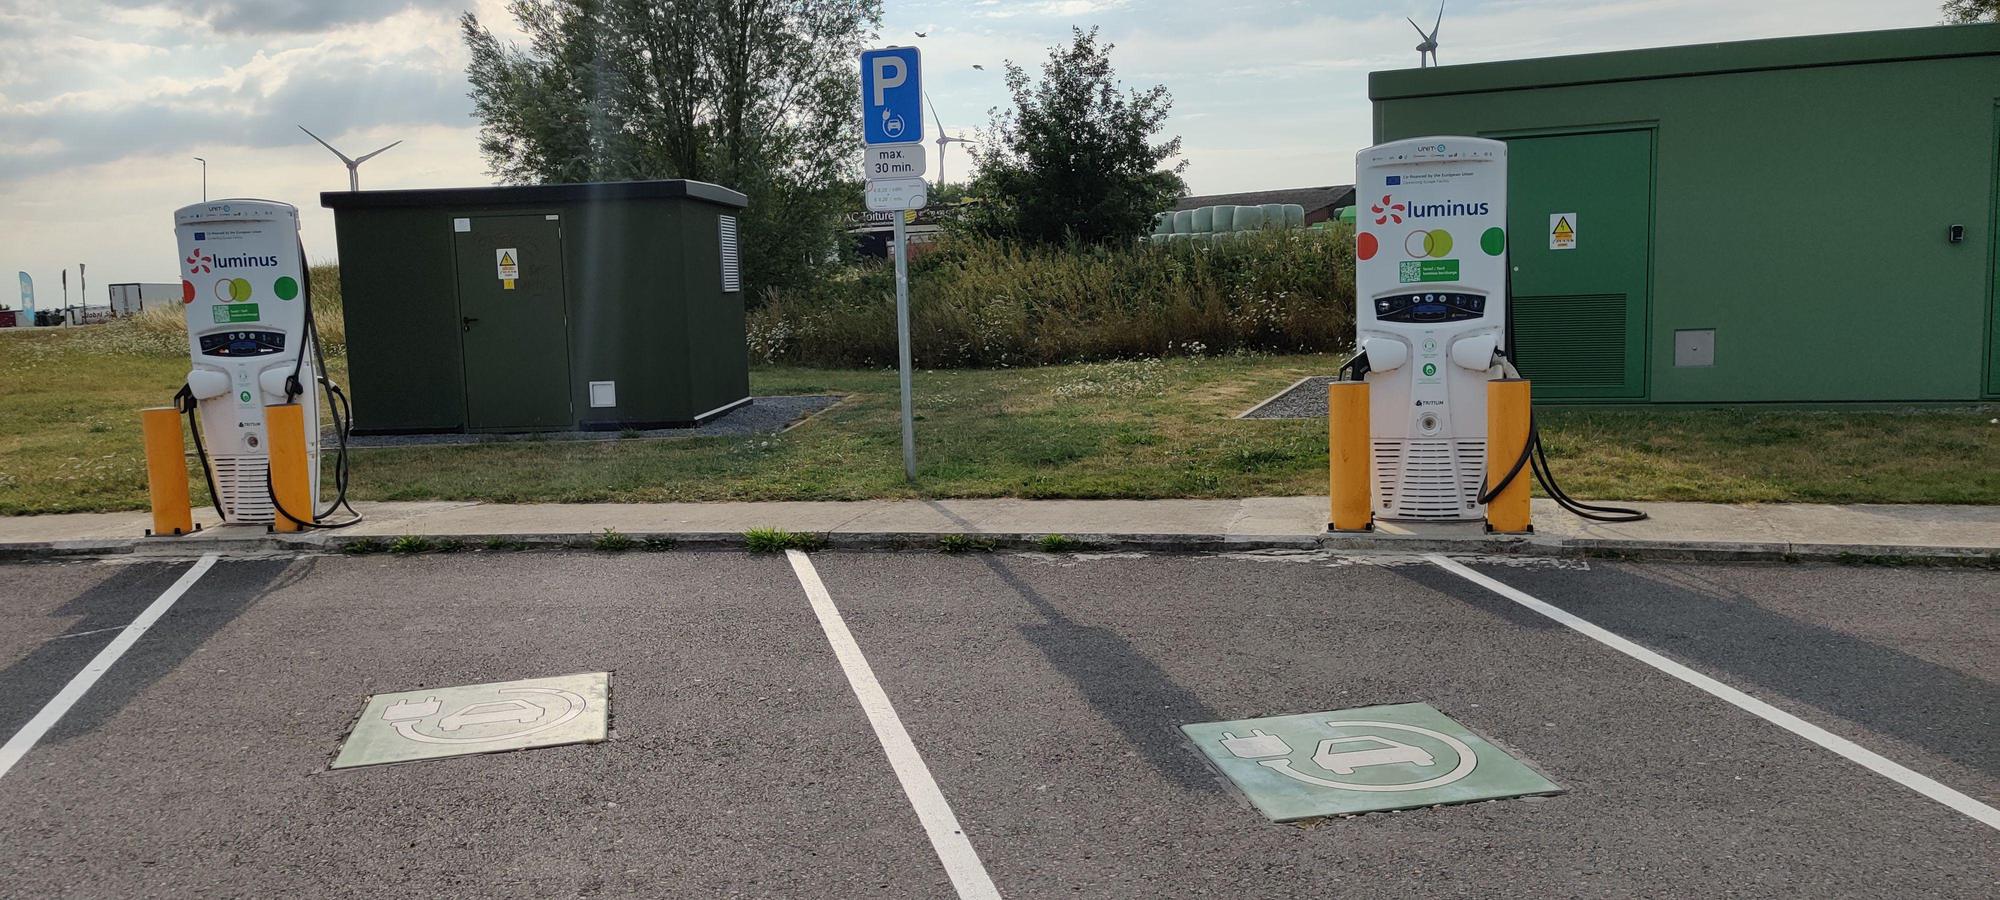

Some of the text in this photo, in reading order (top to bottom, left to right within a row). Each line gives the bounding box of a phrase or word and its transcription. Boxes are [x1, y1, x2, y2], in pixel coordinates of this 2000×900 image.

[872, 56, 908, 107] P
[879, 150, 905, 159] max.
[875, 162, 914, 173] 30 min.
[1407, 199, 1489, 218] luminus
[212, 252, 278, 268] luminus
